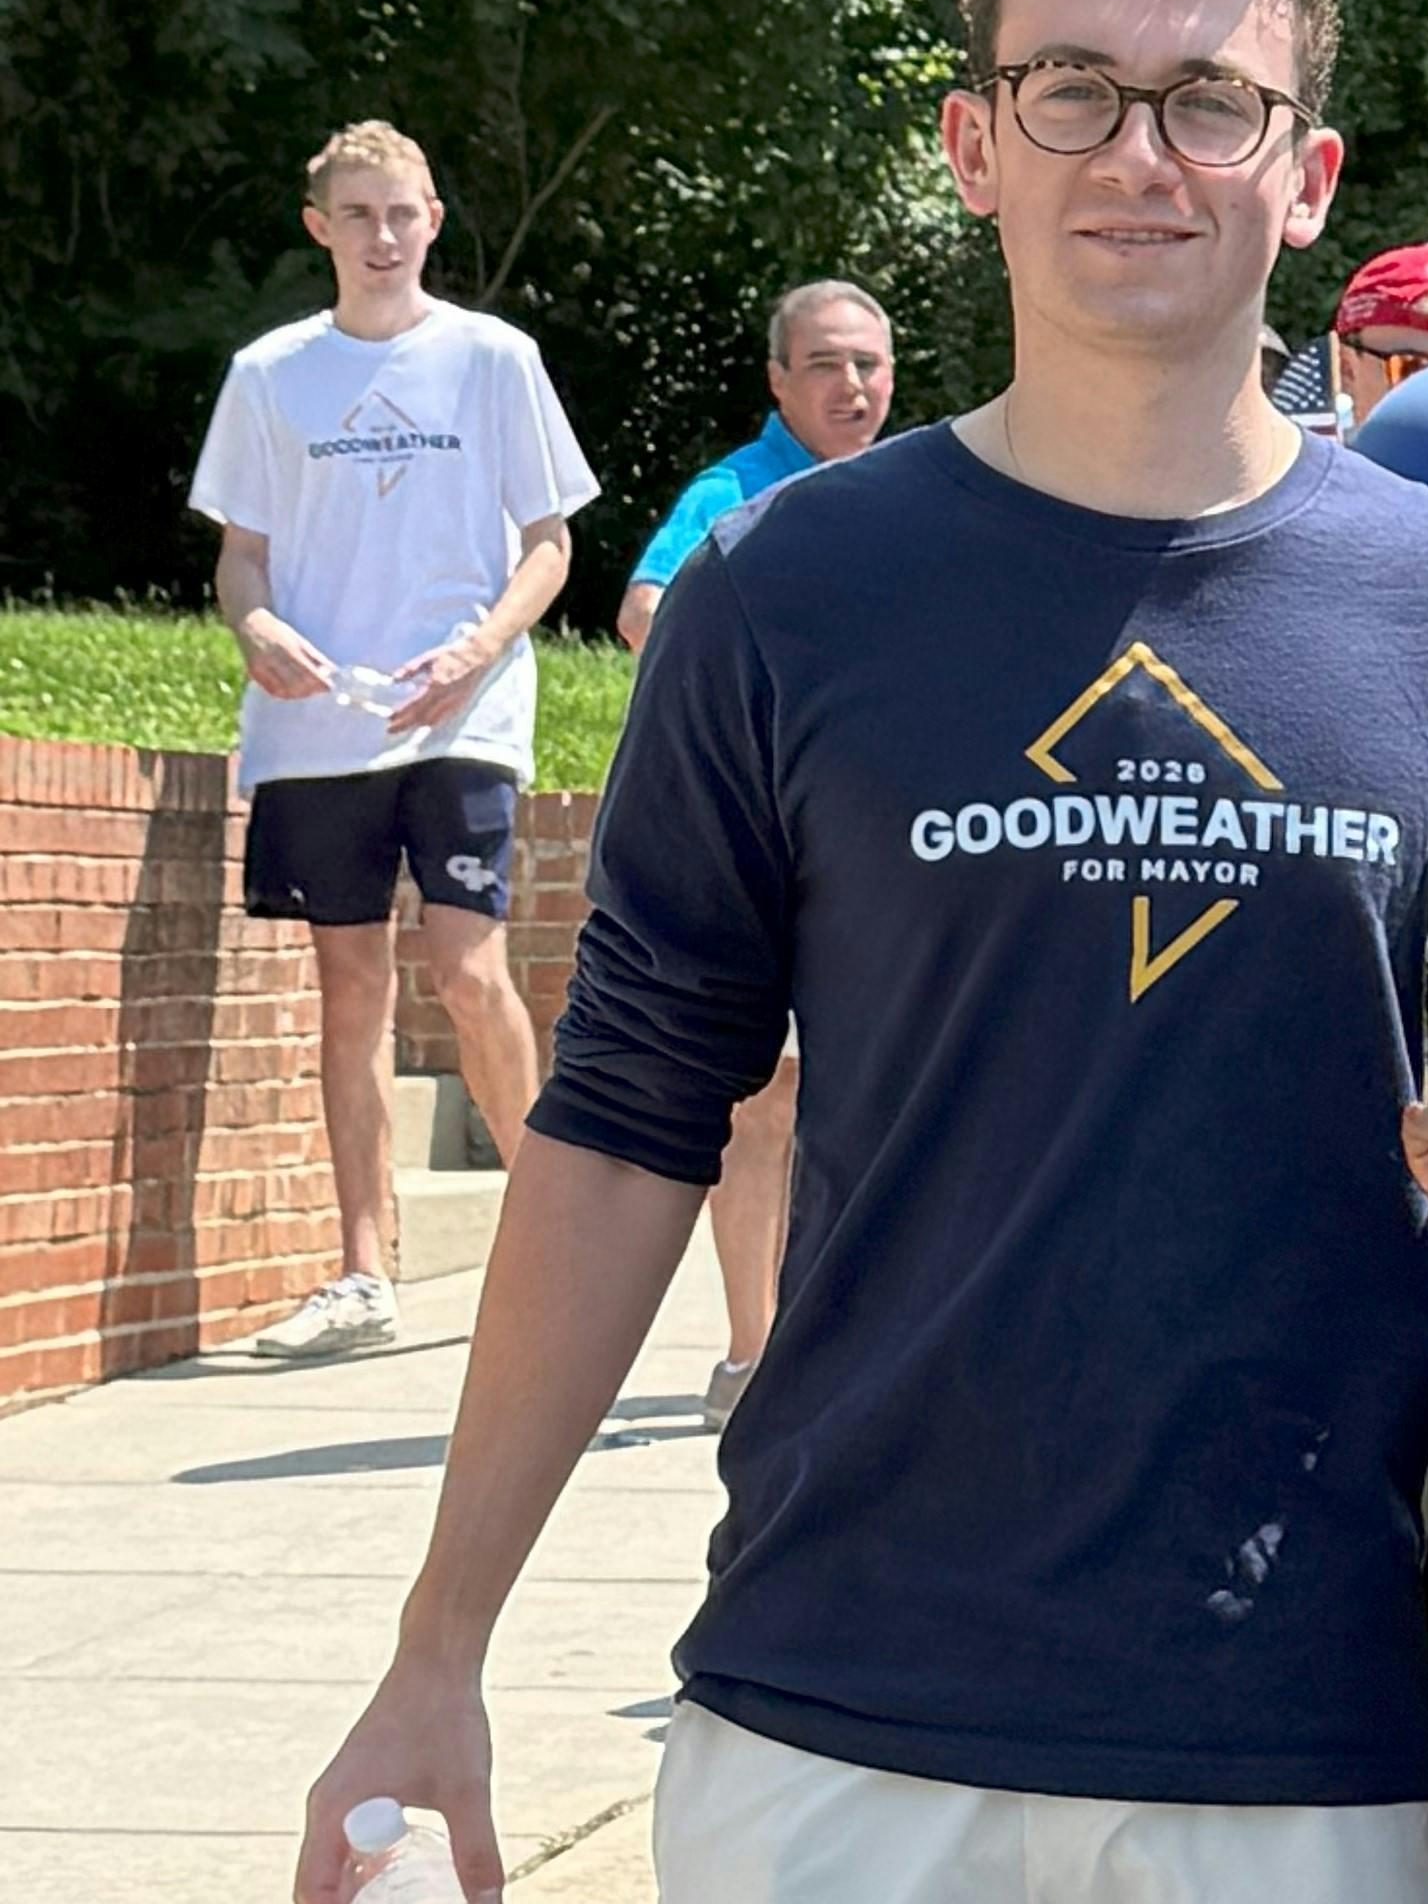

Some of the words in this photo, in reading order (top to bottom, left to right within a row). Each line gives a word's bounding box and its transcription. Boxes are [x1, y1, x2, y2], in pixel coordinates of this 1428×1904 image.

[1117, 759, 1206, 784] 2026
[910, 795, 1400, 865] GOODWEATHER
[1063, 858, 1125, 882] FOR
[1141, 859, 1259, 886] MAYOR
